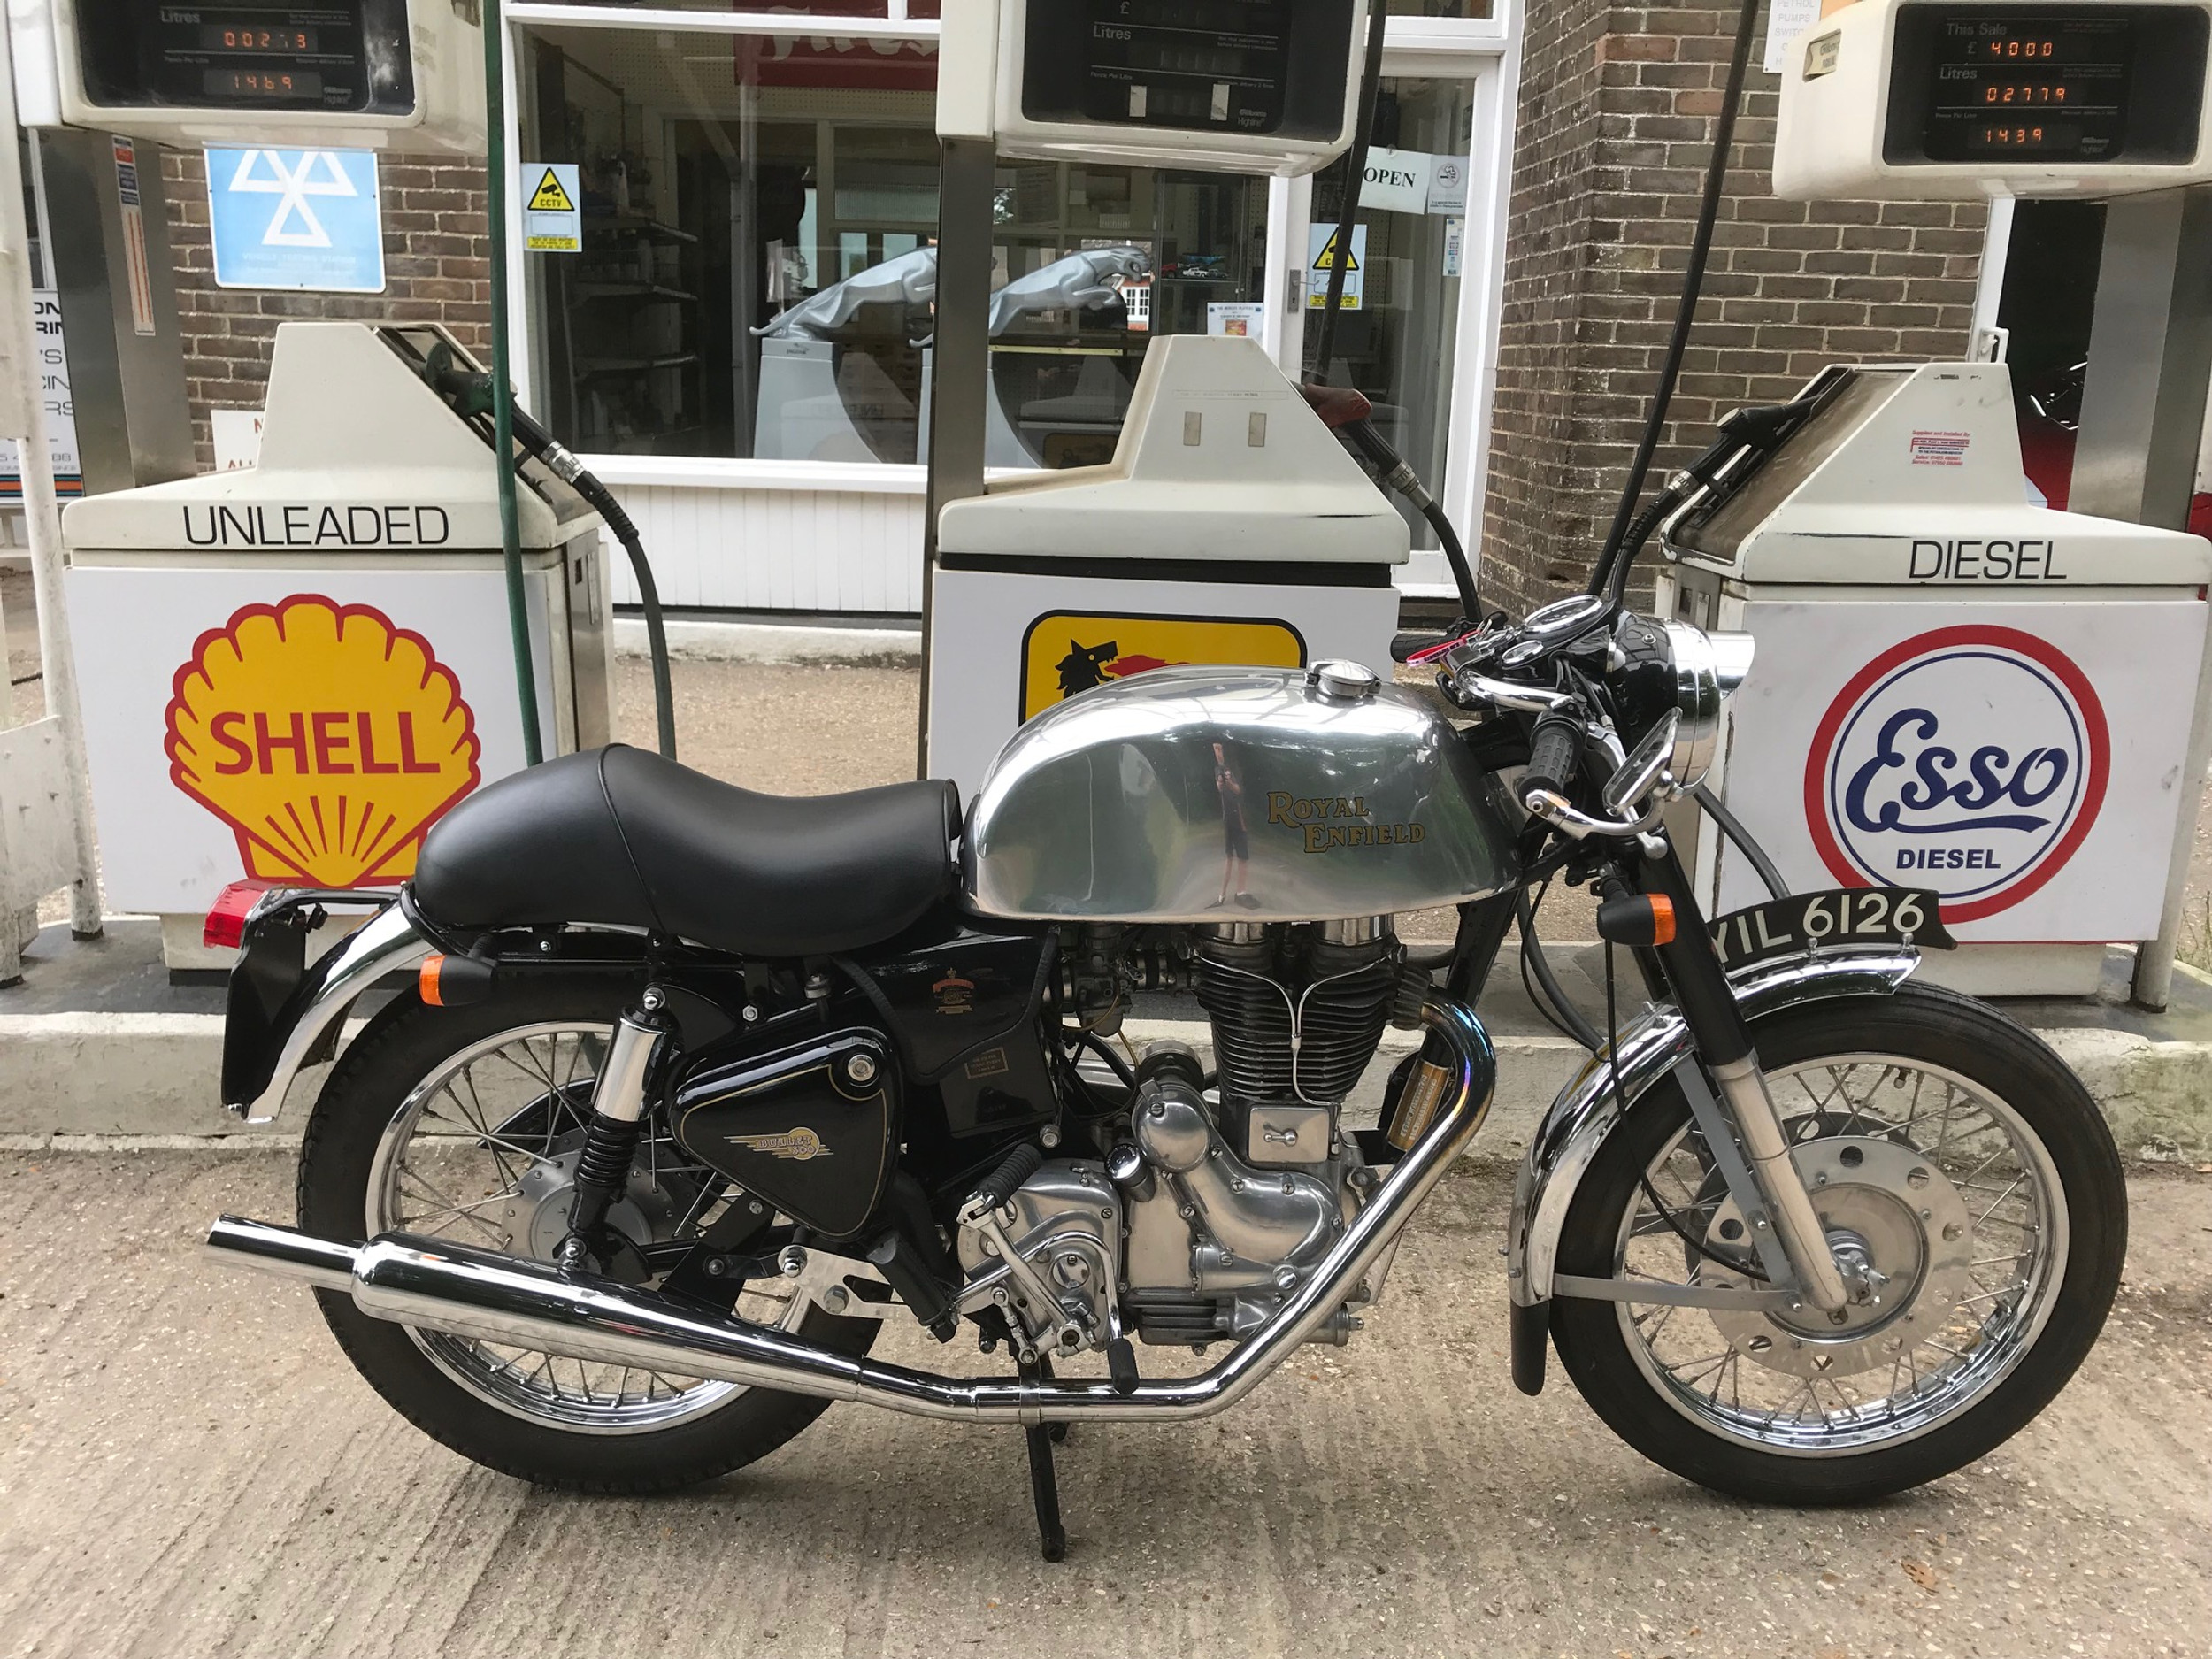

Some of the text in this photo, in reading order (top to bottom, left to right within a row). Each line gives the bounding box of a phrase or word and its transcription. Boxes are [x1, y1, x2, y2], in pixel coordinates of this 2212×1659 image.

[161, 10, 201, 24] Litres
[1778, 13, 1811, 22] PUMPS
[1093, 25, 1132, 41] Litres
[1947, 23, 2008, 36] This Sale
[1991, 42, 2053, 57] 4000
[1939, 67, 1978, 80] Litres
[234, 75, 293, 90] 1469
[1986, 87, 2066, 102] 02779
[1986, 128, 2043, 143] 1439
[1363, 167, 1416, 188] OPEN
[183, 505, 449, 546] UNLEADED
[1909, 540, 2068, 580] DIESEL
[210, 711, 441, 775] SHELL
[1266, 791, 1371, 829] ROYAL
[1303, 822, 1426, 854] ENFIELD
[1896, 849, 2001, 870] DIESEL
[1802, 892, 1924, 938] 6126
[758, 1136, 813, 1148] BULLET
